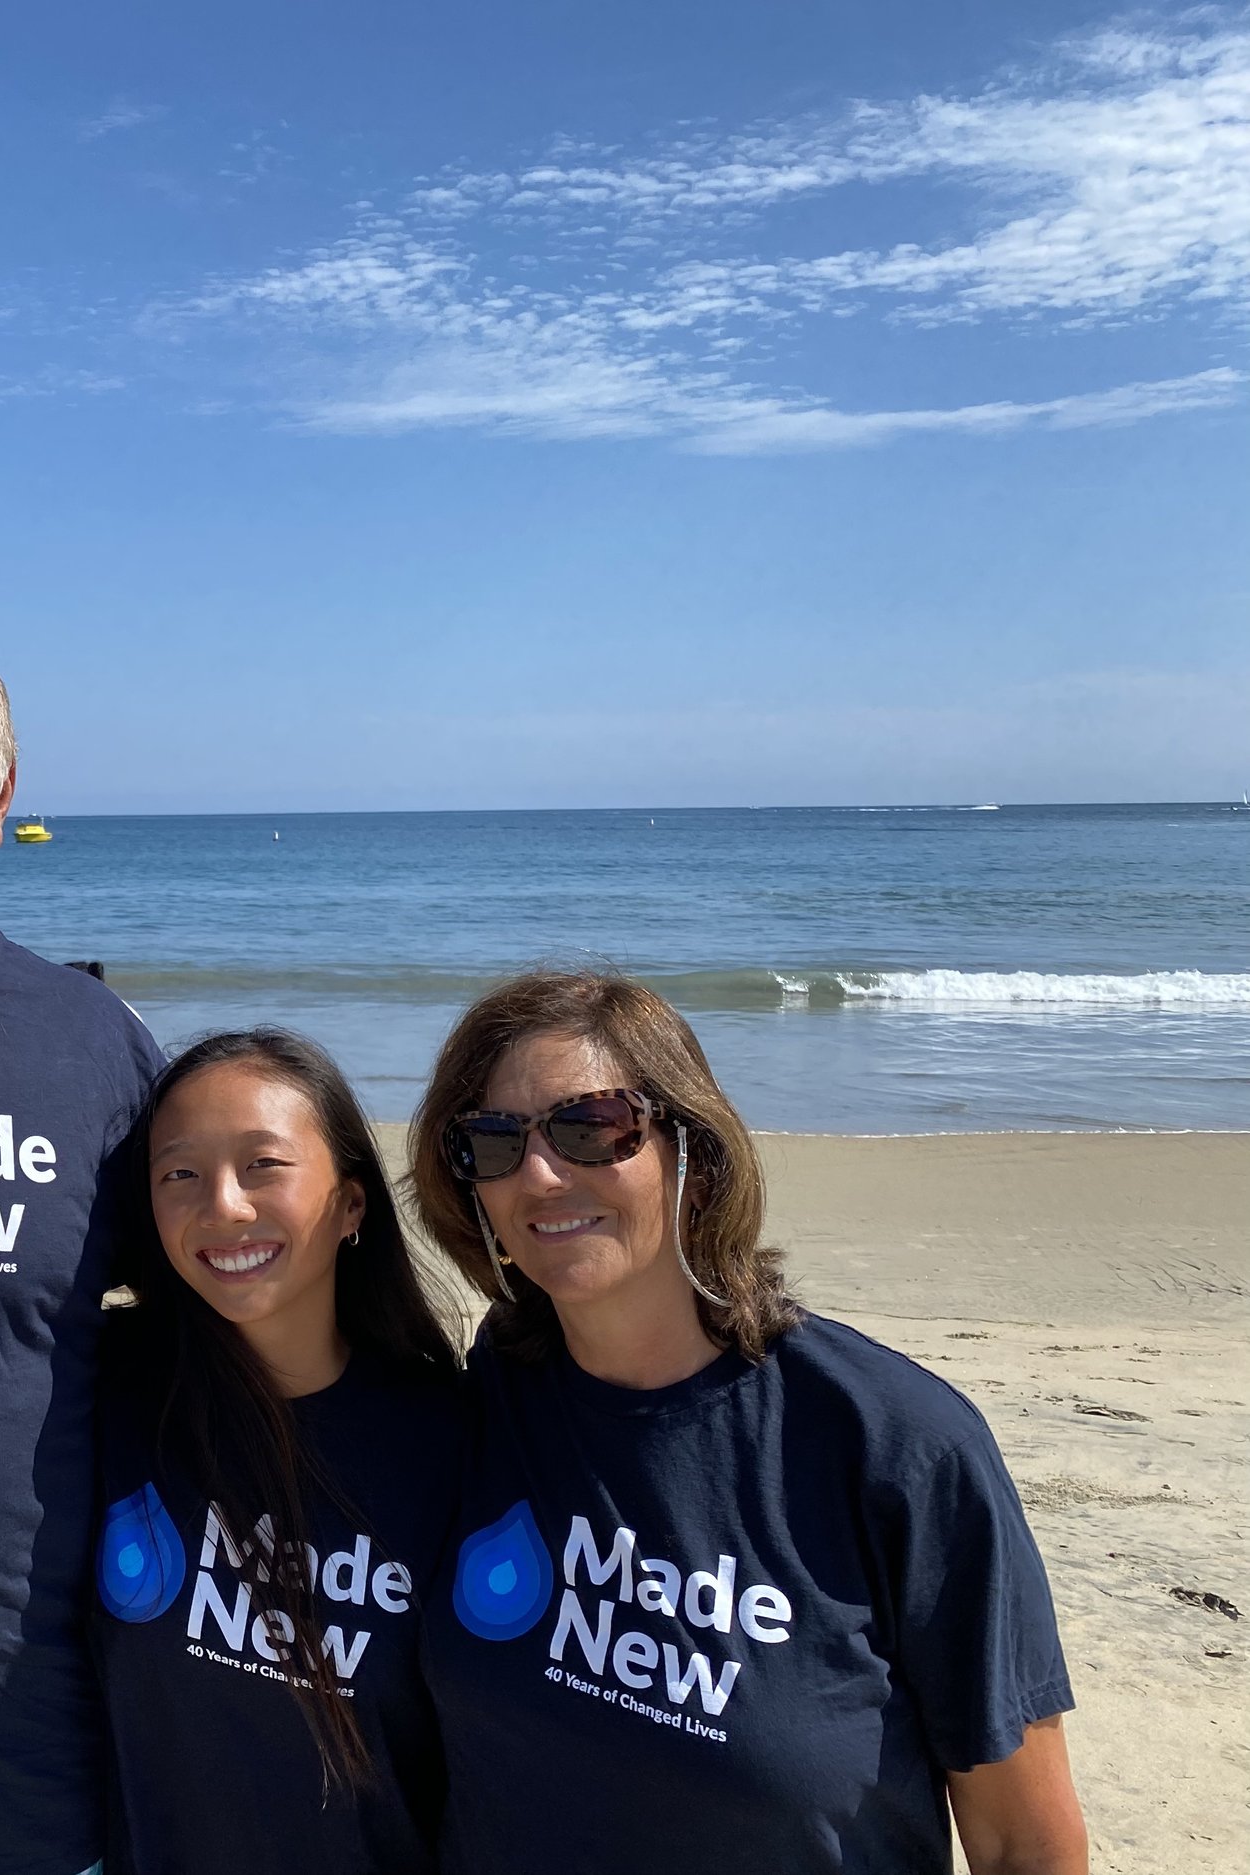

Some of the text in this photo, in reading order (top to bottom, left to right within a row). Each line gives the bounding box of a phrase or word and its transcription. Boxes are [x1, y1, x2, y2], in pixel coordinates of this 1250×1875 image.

[186, 1570, 372, 1679] New
[563, 1515, 793, 1644] Made
[186, 1644, 204, 1658] 40
[205, 1648, 241, 1669] Years
[243, 1662, 258, 1674] of
[259, 1665, 314, 1690] Chage
[544, 1666, 727, 1743] 40 Years of Changed Lives
[549, 1588, 742, 1717] New
